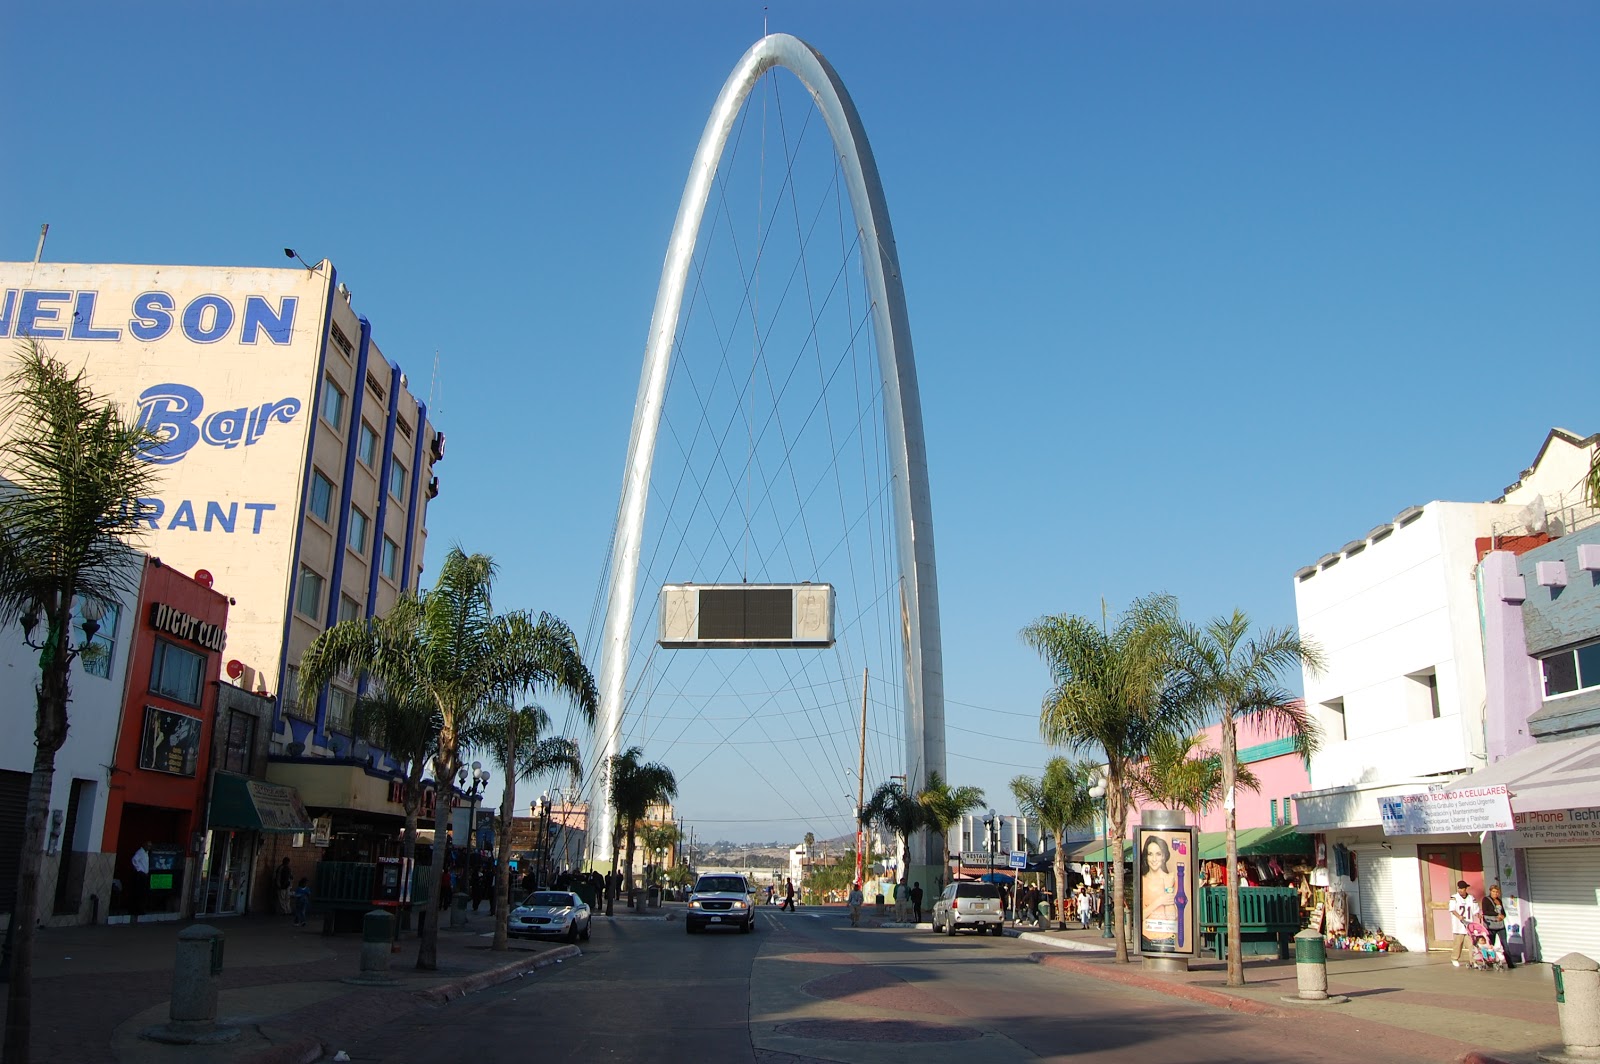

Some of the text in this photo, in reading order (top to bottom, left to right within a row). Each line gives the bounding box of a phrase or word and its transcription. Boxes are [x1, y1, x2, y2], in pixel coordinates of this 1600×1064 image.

[136, 383, 302, 465] Bar
[155, 602, 228, 653] NIGHT CLUB
[1403, 794, 1429, 803] SERVICIO
[1430, 791, 1457, 801] TECNICO
[1465, 786, 1506, 798] CELULARES
[1513, 812, 1526, 824] ell
[1530, 811, 1564, 823] Phone
[1459, 905, 1471, 919] 21
